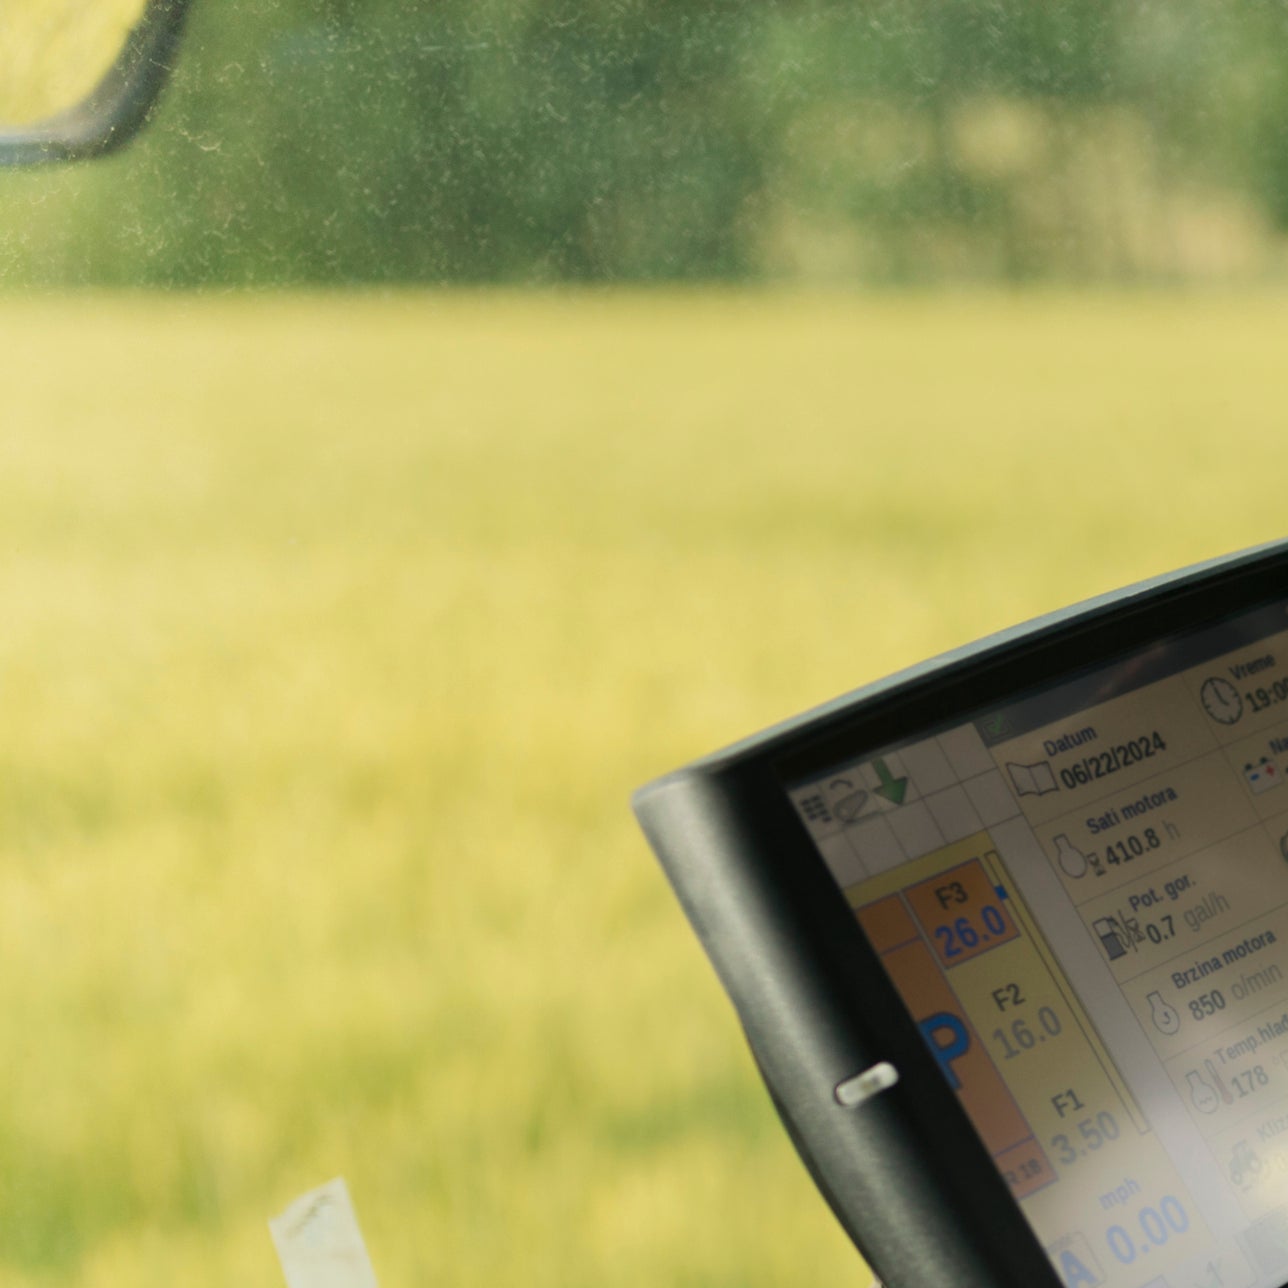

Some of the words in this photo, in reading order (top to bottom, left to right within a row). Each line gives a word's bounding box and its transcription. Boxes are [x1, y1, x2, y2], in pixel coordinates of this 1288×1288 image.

[1228, 653, 1276, 680] Vreme
[1043, 726, 1097, 757] Datum
[1060, 732, 1165, 788] 06/22/2024
[1085, 807, 1120, 834] Sati
[1120, 787, 1177, 819] motora
[1106, 827, 1160, 865] 410.8
[1161, 820, 1181, 840] h
[934, 881, 969, 911] F3
[1128, 889, 1163, 911] Pot.
[1163, 874, 1196, 900] gor.
[933, 904, 1006, 958] 26.0
[1145, 914, 1175, 944] 0.7
[1182, 891, 1230, 931] gal/h
[1170, 957, 1223, 989] Brzina
[1221, 930, 1276, 965] motora
[991, 982, 1026, 1011] F2
[1188, 989, 1225, 1020] 850
[1230, 963, 1283, 1000] o/min
[990, 1005, 1061, 1058] 16.0
[1050, 1089, 1085, 1118] F1
[1230, 1064, 1269, 1098] 178
[1050, 1109, 1120, 1165] 3.50
[1098, 1177, 1141, 1210] mph
[1105, 1195, 1190, 1265] 0.00
